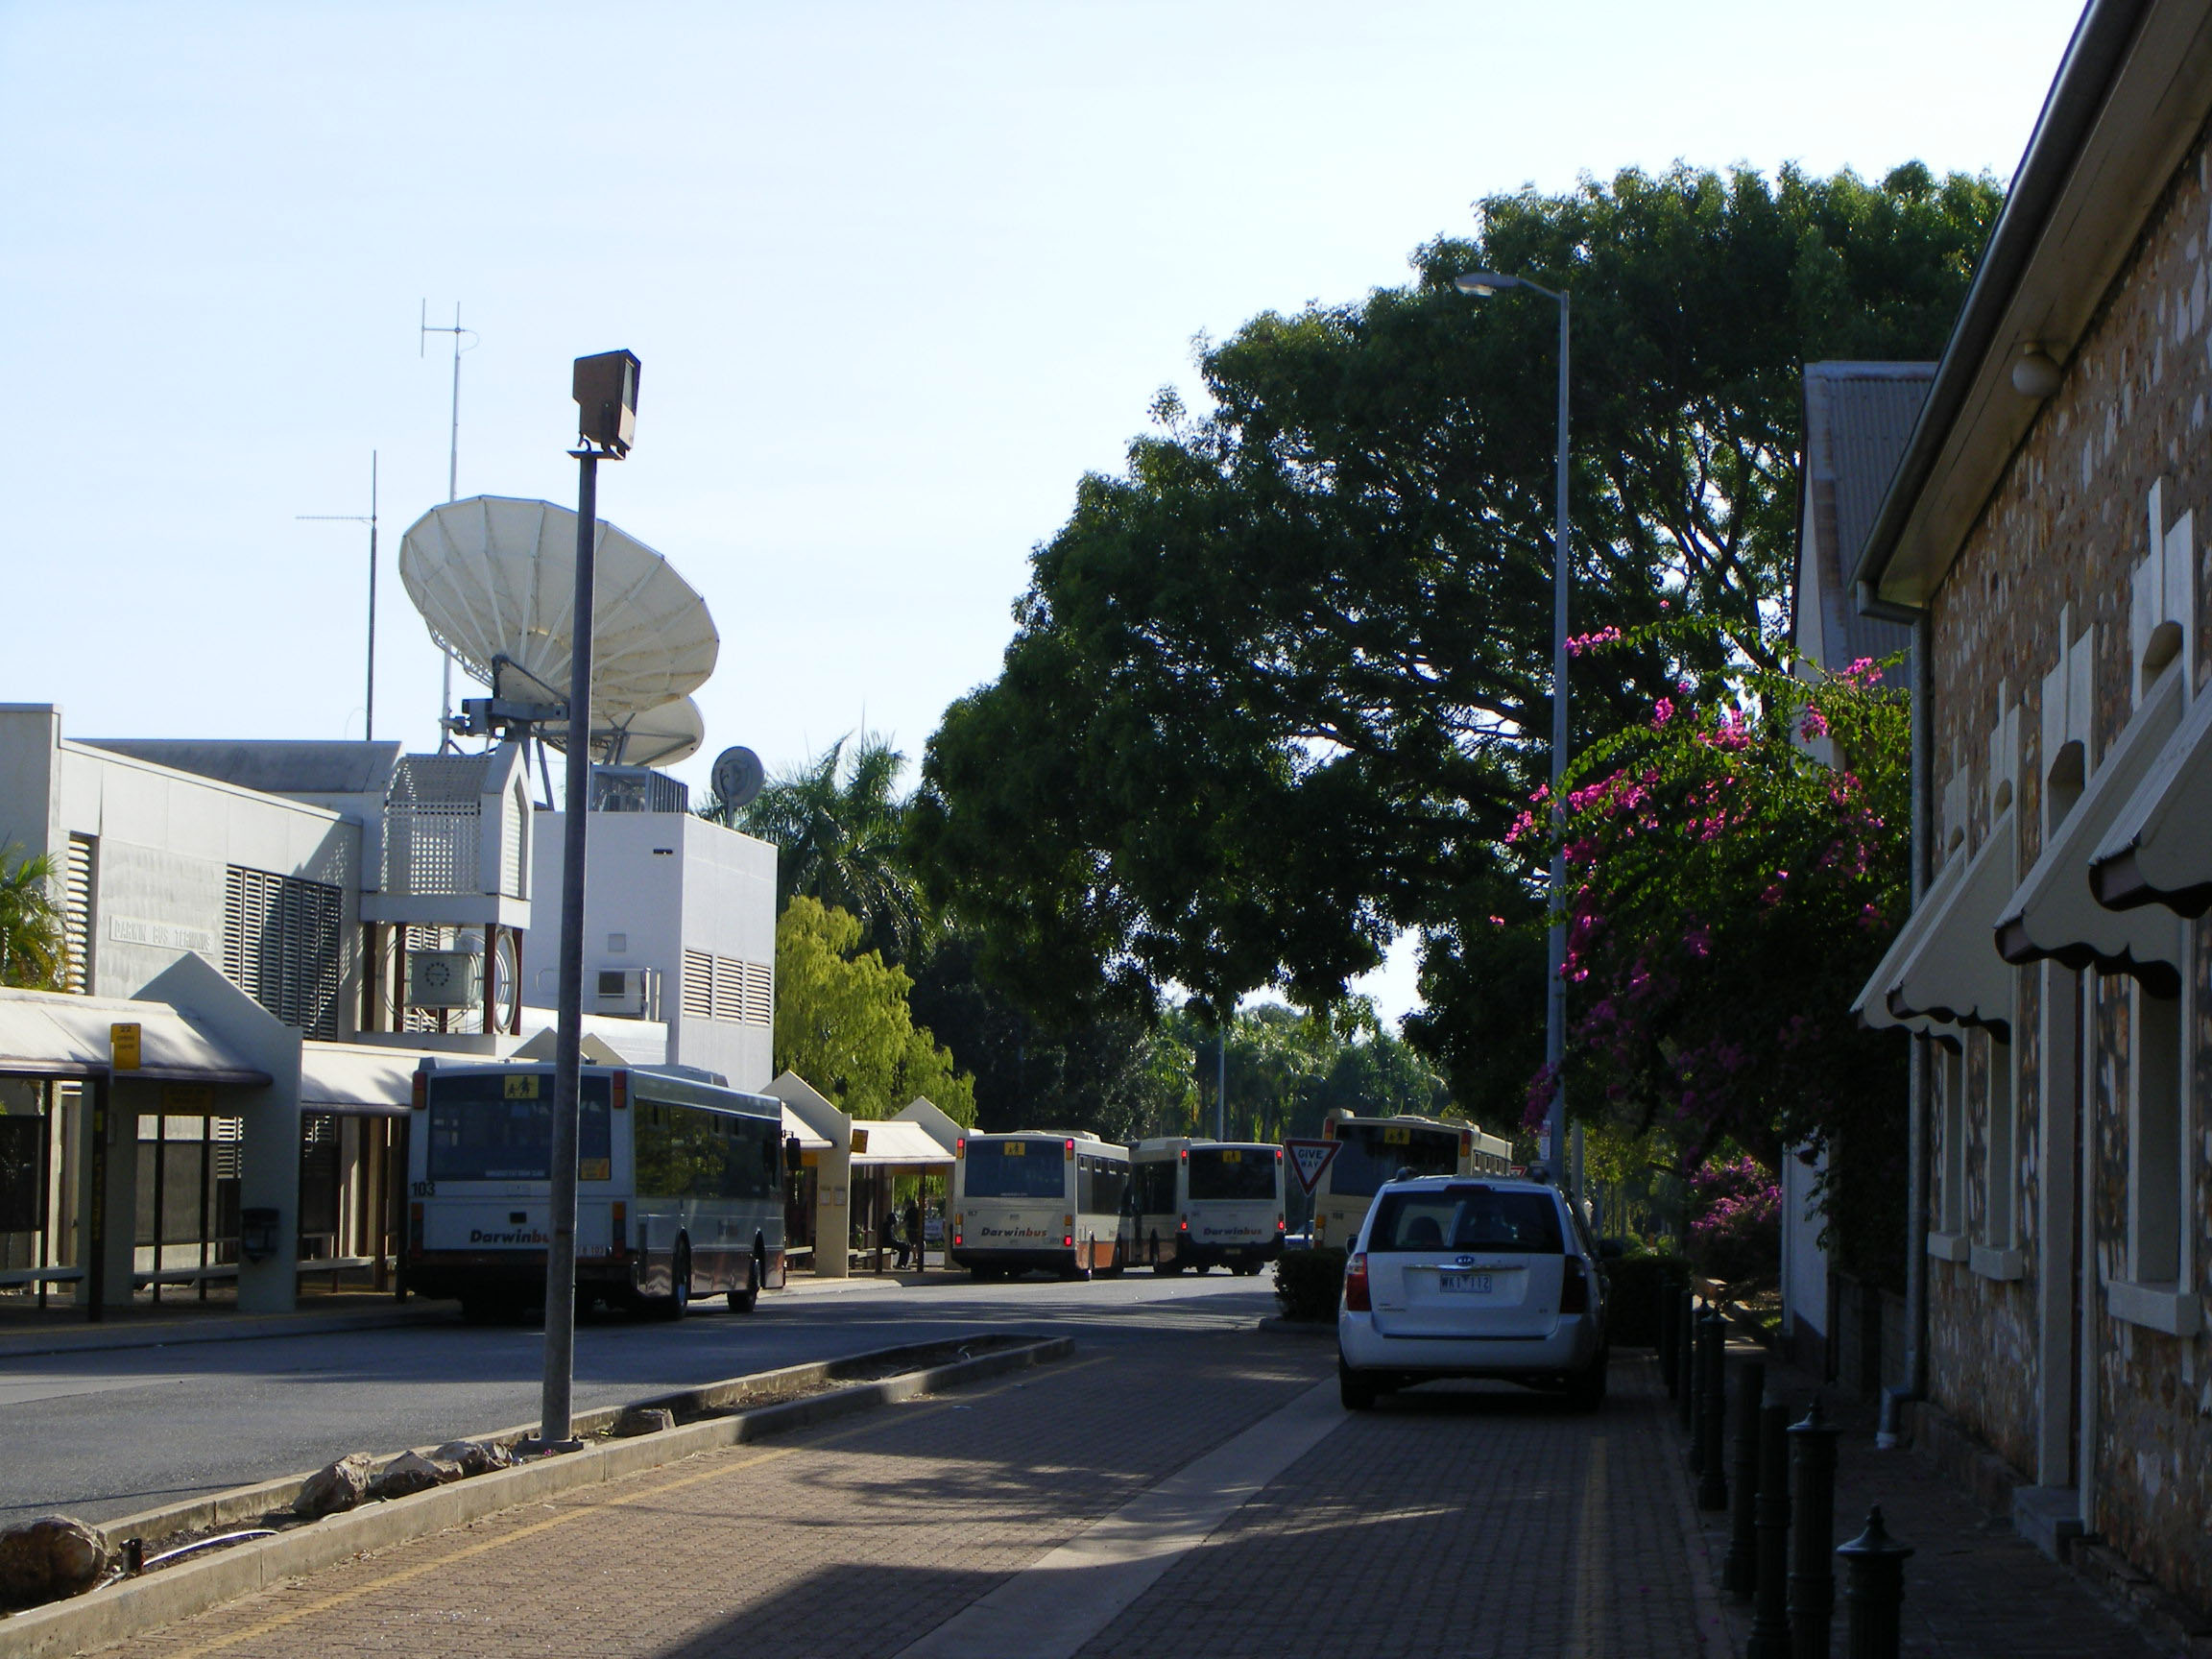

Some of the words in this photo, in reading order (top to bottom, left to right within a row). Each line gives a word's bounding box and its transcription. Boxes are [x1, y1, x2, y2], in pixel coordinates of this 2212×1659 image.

[114, 920, 147, 942] DARWIN
[153, 926, 169, 945] BUS
[174, 928, 211, 950] TERMINUS
[1298, 1149, 1323, 1160] GIVE
[1301, 1160, 1319, 1168] WAY
[411, 1182, 436, 1196] 103
[469, 1229, 550, 1243] Darwinbu
[981, 1227, 1047, 1238] Darwinbus
[1203, 1227, 1262, 1236] Darwinbus
